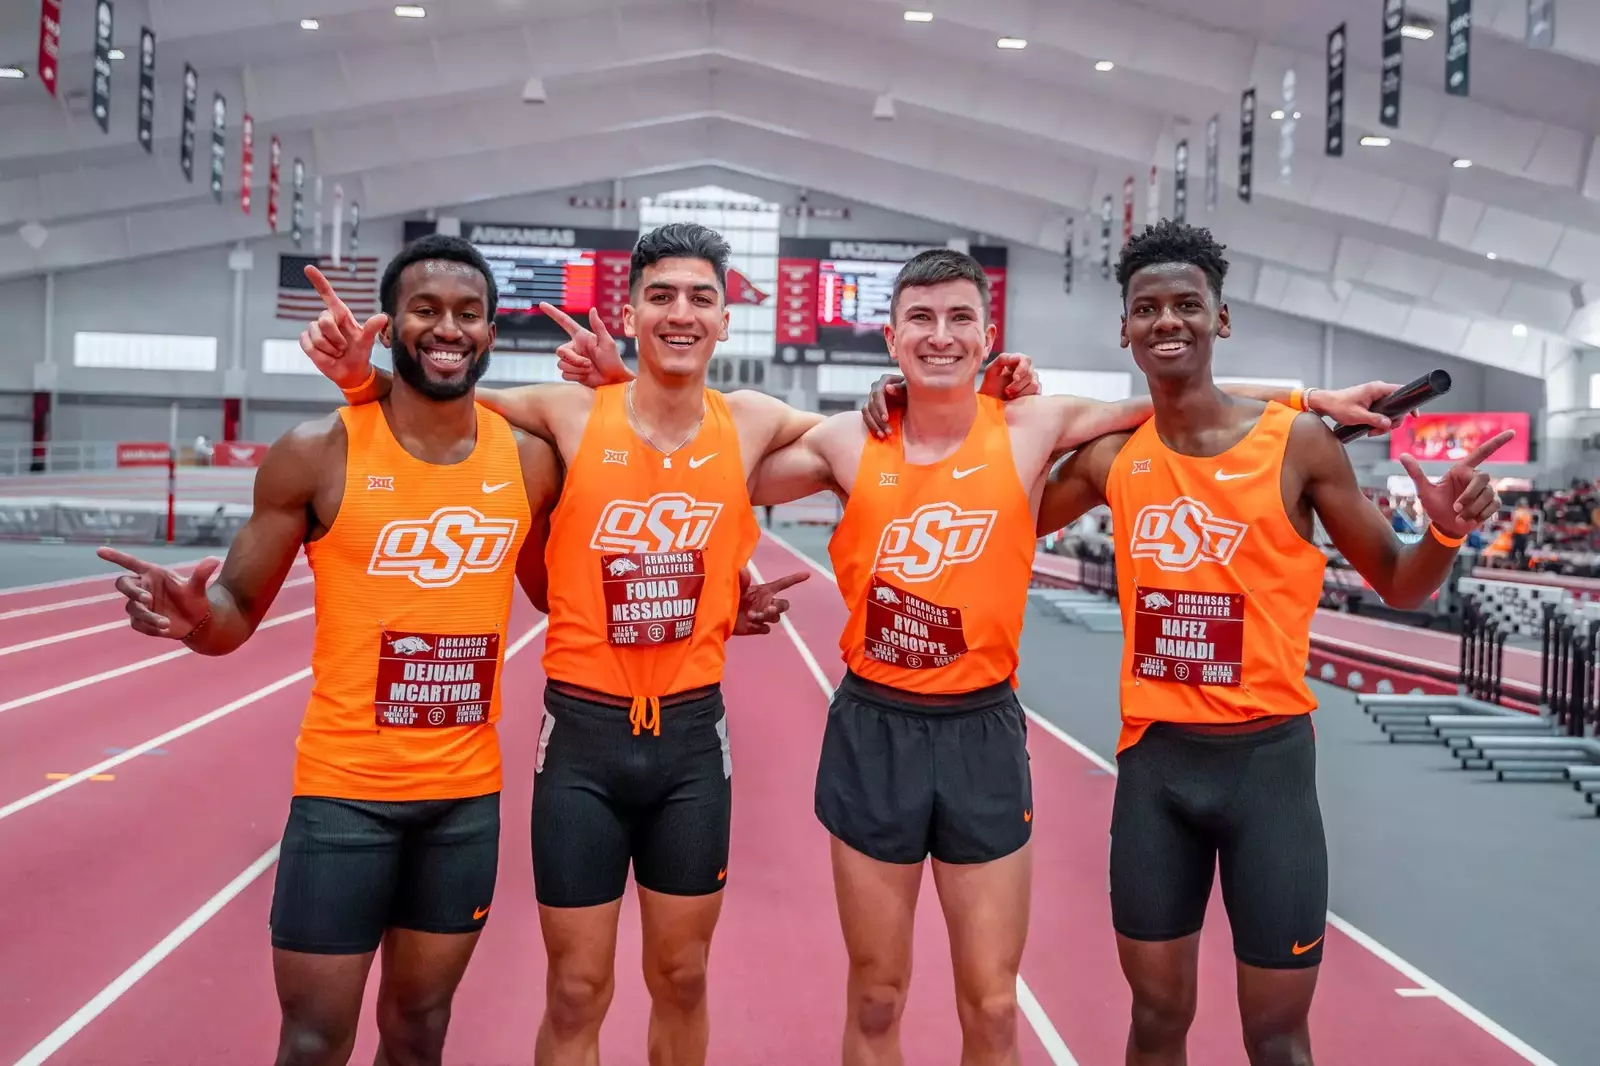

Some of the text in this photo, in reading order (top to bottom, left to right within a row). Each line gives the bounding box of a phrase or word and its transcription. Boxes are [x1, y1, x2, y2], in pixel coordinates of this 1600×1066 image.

[599, 499, 715, 553] OSU
[1135, 502, 1239, 565] OSU
[377, 513, 512, 581] OSU
[879, 509, 988, 576] OSU
[644, 553, 694, 565] ARKANSAS
[645, 563, 694, 576] QUALIFIER
[626, 580, 679, 600] FOUAD
[1178, 594, 1231, 606] ARKANSAS
[612, 598, 696, 622] MESSAOUDI
[905, 596, 948, 617] ARKANSAS
[906, 605, 949, 626] QUALIFIER
[1177, 605, 1230, 617] QUALIFIER
[894, 614, 929, 639] RYAN
[1162, 618, 1207, 639] HAFEZ
[439, 637, 488, 647] ARKANSAS
[881, 627, 948, 655] SCHOPPE
[1155, 637, 1215, 660] MAHADI
[438, 647, 486, 659] QUALIFIER
[404, 663, 474, 682] DEJUANA
[390, 683, 481, 702] MCARTHUR
